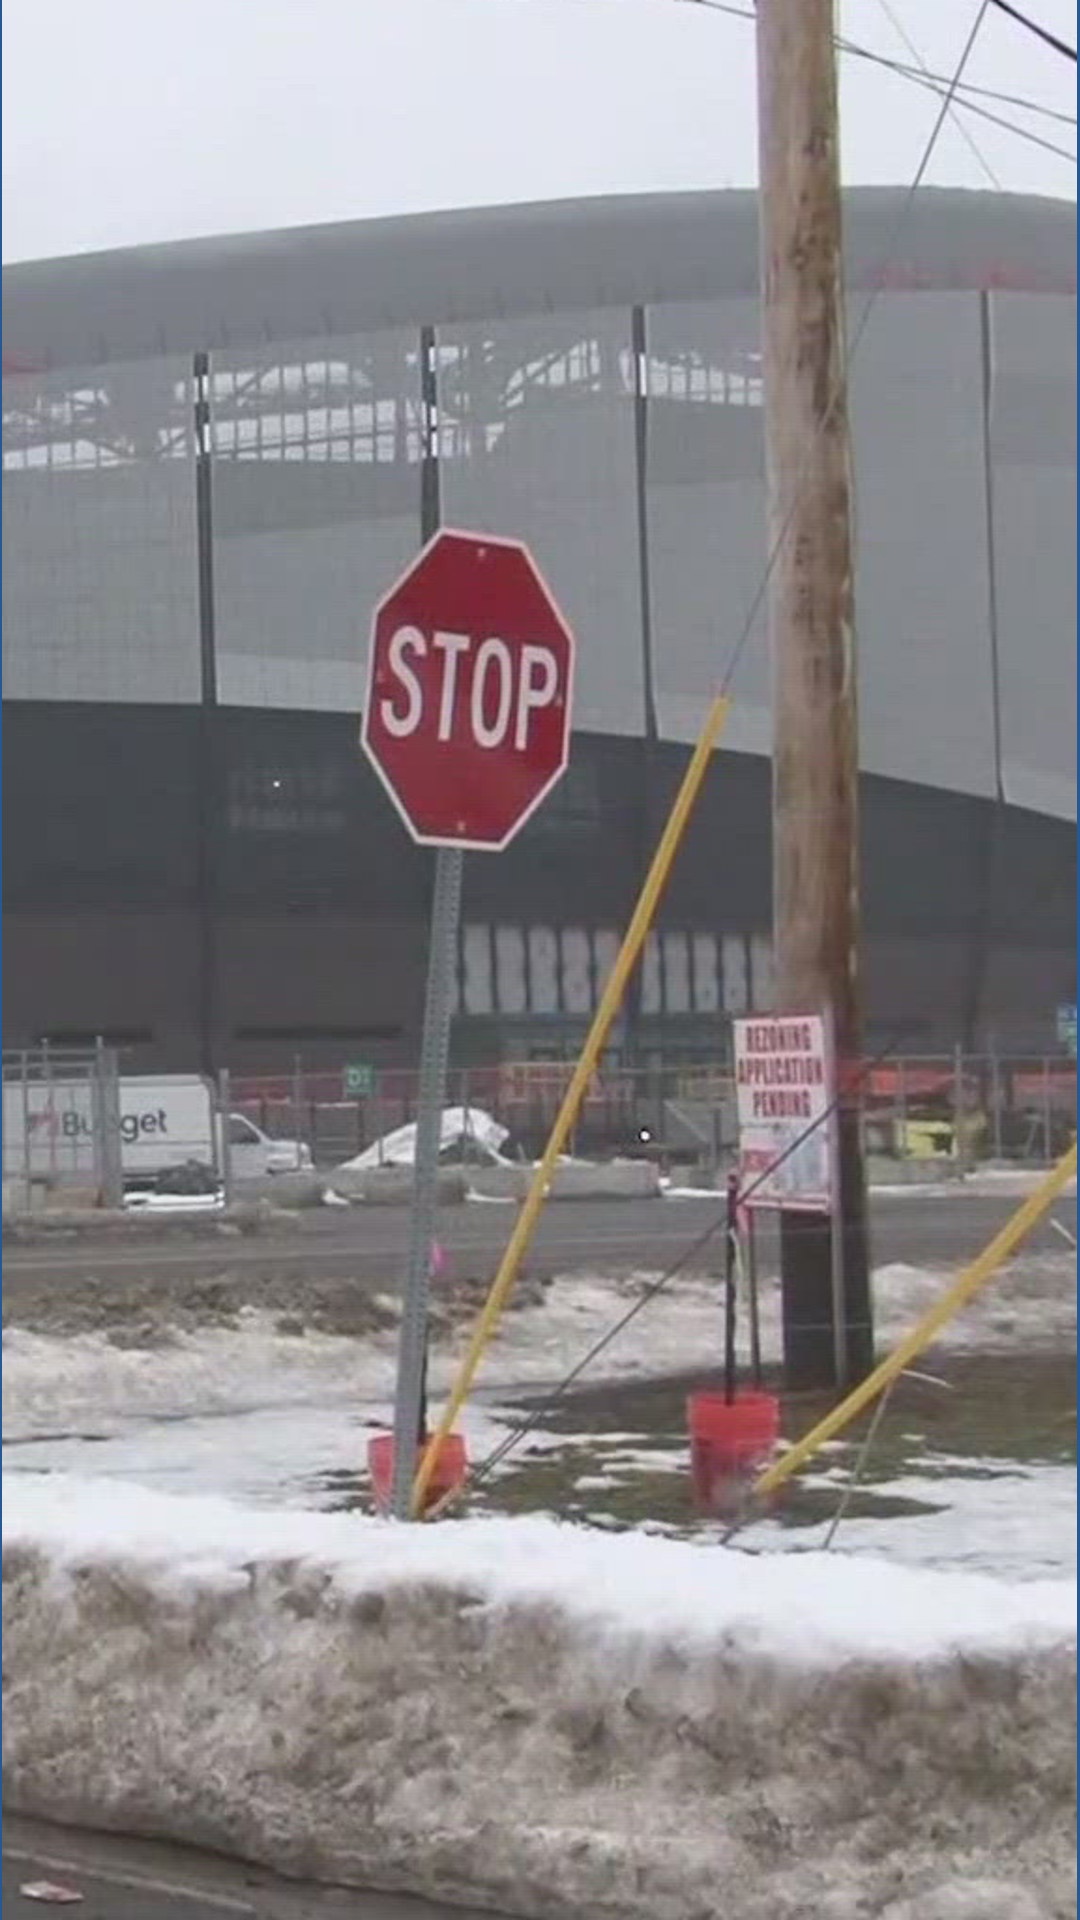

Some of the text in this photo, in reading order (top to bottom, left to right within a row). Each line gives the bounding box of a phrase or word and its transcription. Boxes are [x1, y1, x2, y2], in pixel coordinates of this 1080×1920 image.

[381, 625, 557, 750] STOP
[746, 1024, 811, 1052] REZONING
[738, 1057, 823, 1085] APPLICATION
[753, 1090, 811, 1118] PENDING
[62, 1108, 168, 1143] Buget
